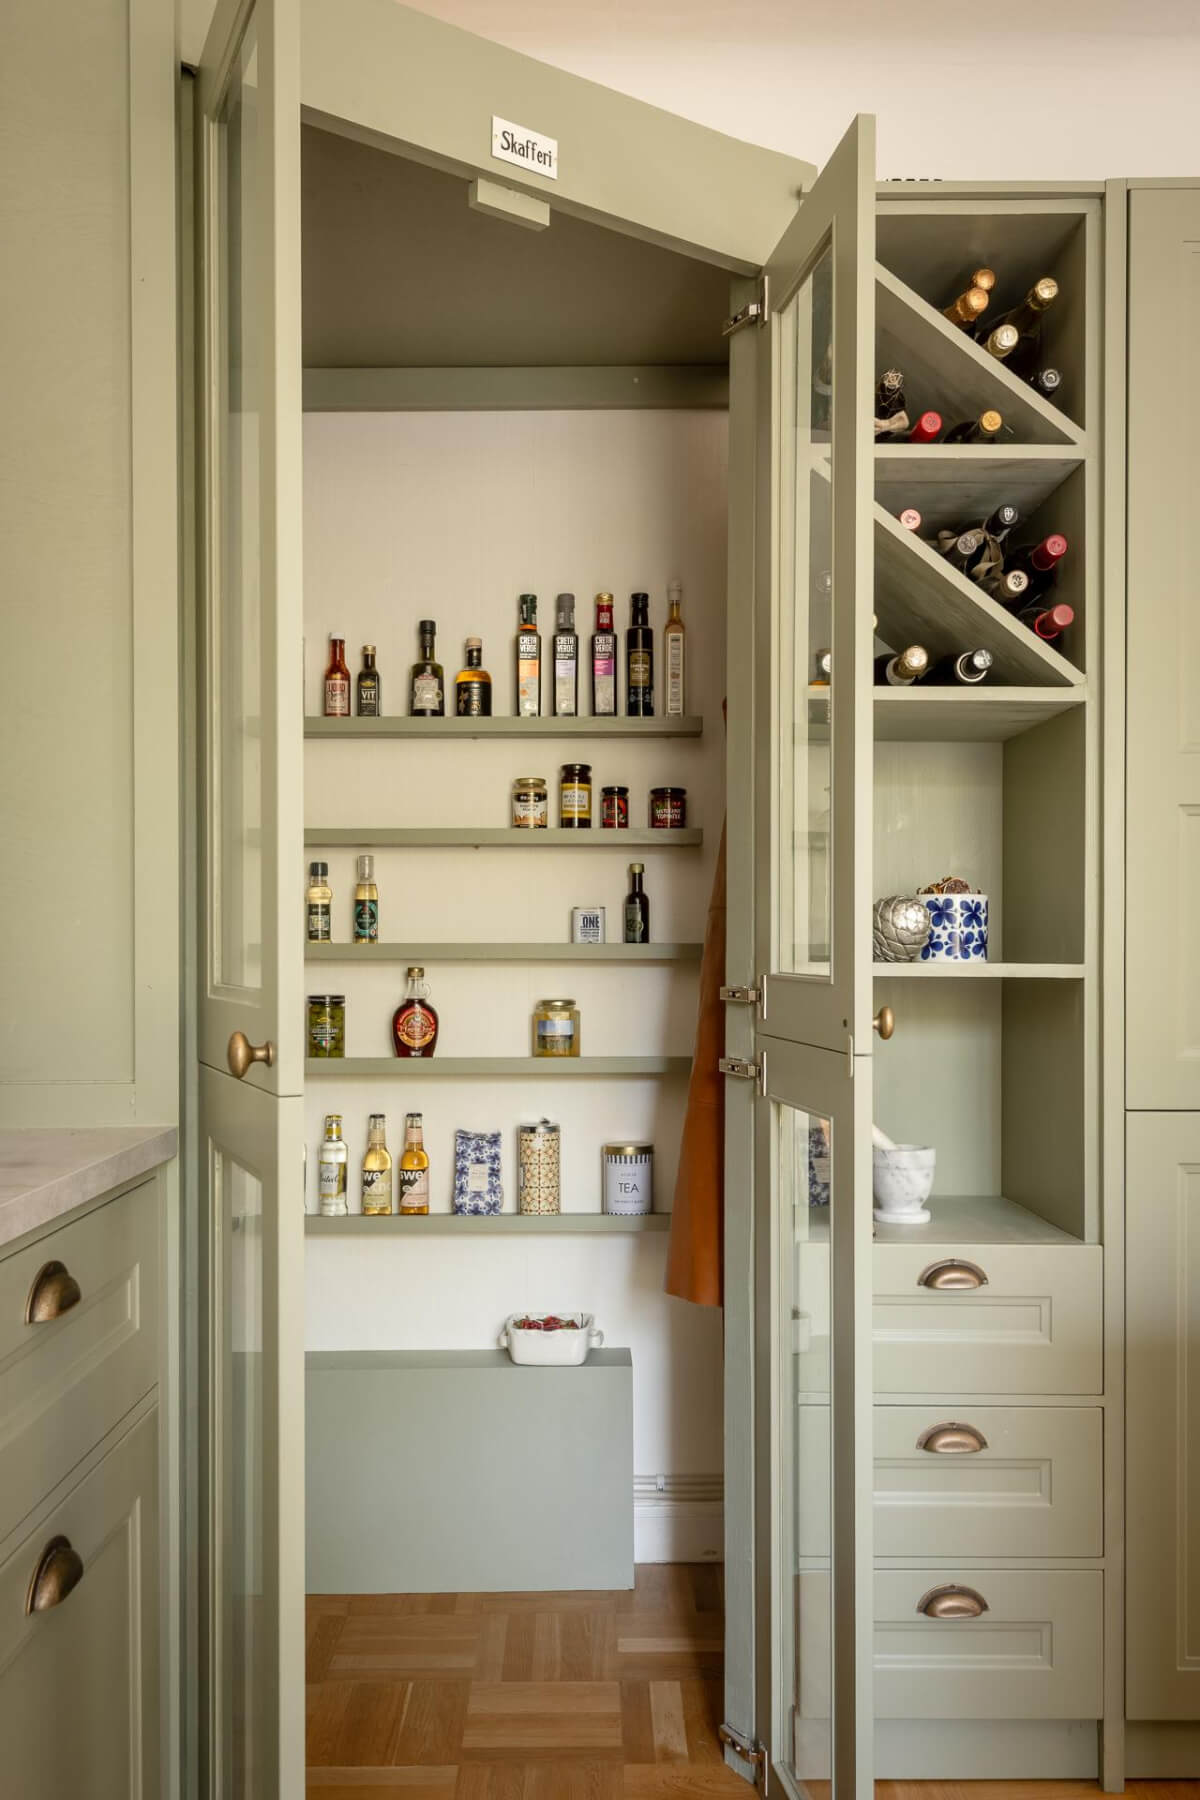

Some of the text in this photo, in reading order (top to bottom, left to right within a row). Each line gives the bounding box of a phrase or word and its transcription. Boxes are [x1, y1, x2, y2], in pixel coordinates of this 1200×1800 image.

[500, 130, 552, 167] Skafferi
[361, 690, 376, 700] VIT
[618, 1182, 639, 1194] TEA
